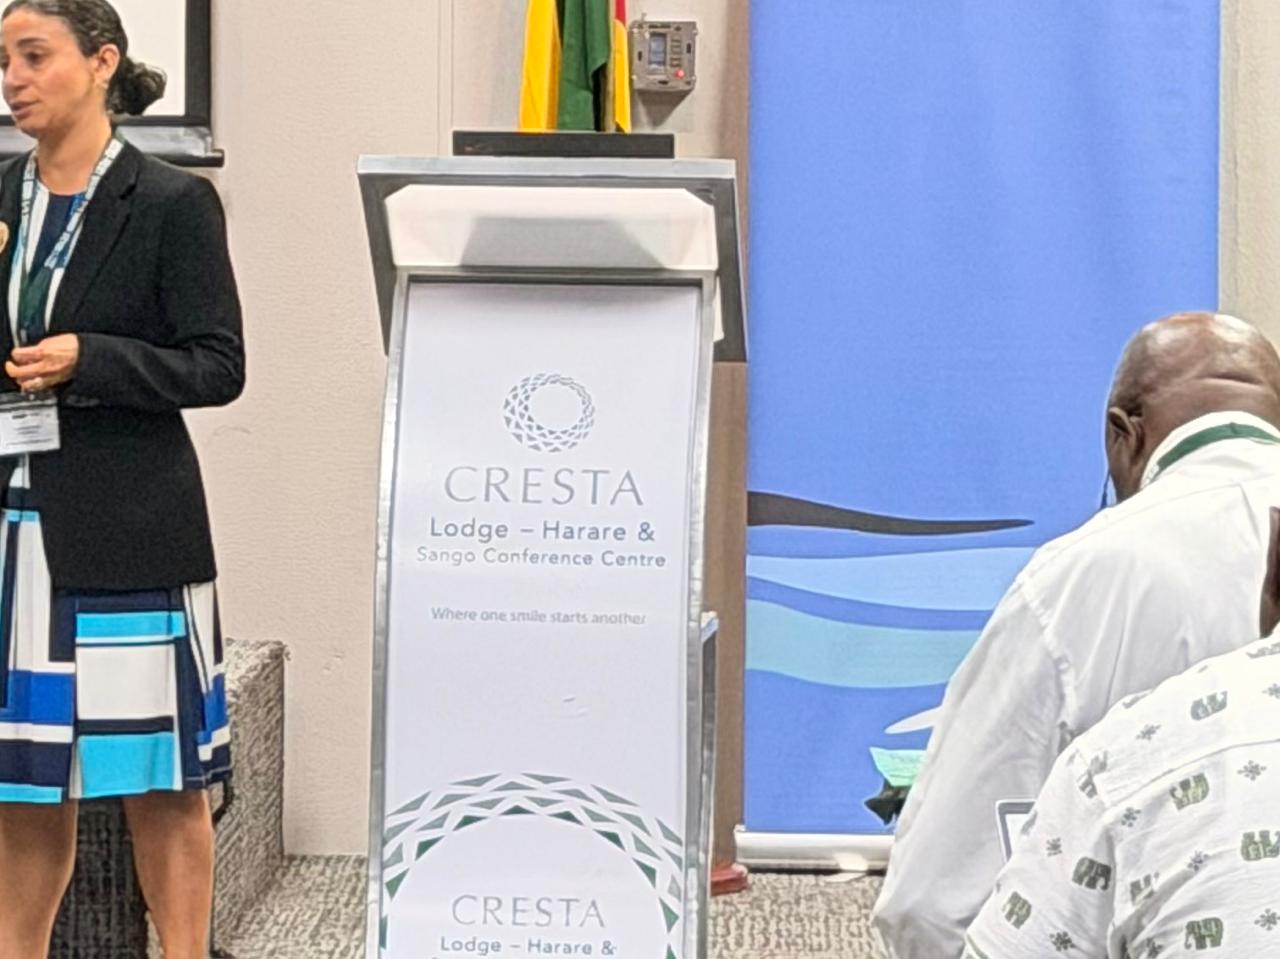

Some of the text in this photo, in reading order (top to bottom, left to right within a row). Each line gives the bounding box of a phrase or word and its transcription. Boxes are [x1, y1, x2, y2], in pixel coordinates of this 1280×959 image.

[444, 466, 644, 506] CRESTA
[430, 517, 509, 544] Lodge
[542, 520, 627, 541] Harare
[637, 521, 655, 542] &
[417, 545, 667, 568] Sango Conference Centre
[431, 607, 646, 625] Where one smile starts another
[452, 894, 605, 928] CRESTA
[440, 936, 502, 957] Lodge
[527, 938, 593, 956] Harare
[601, 940, 617, 956] &
